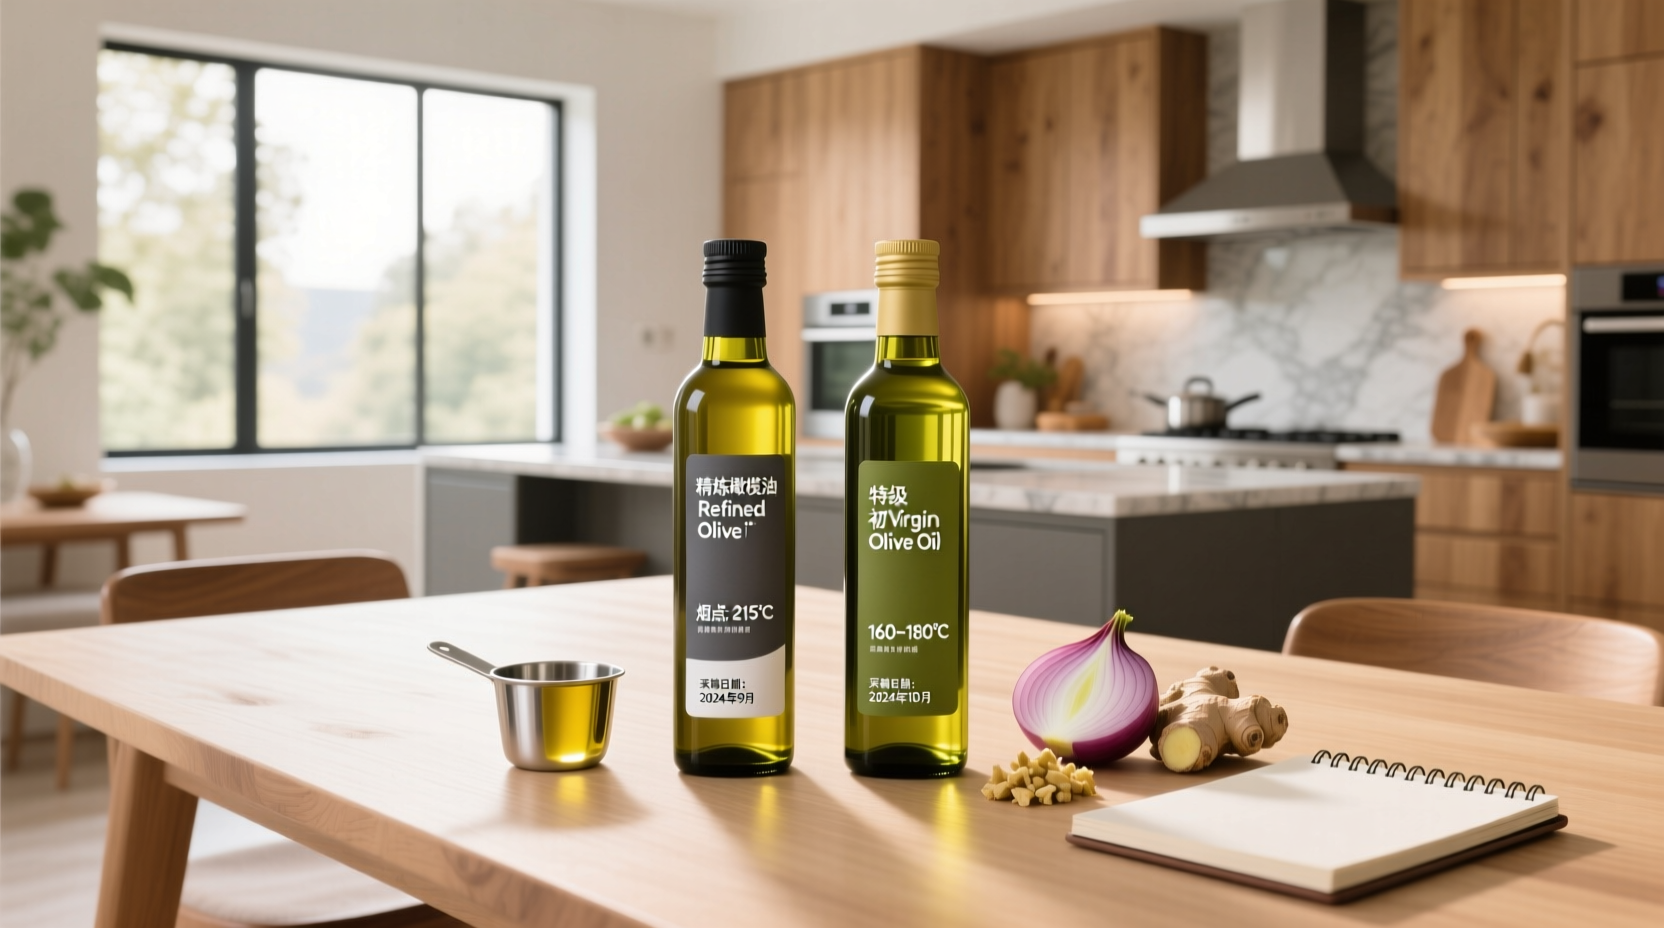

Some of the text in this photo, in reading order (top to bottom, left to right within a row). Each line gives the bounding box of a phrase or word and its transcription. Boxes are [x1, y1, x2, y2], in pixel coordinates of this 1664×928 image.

[868, 485, 908, 506] 特级
[698, 499, 766, 517] Refined
[697, 521, 742, 539] Olive
[868, 531, 941, 551] Olive Oil
